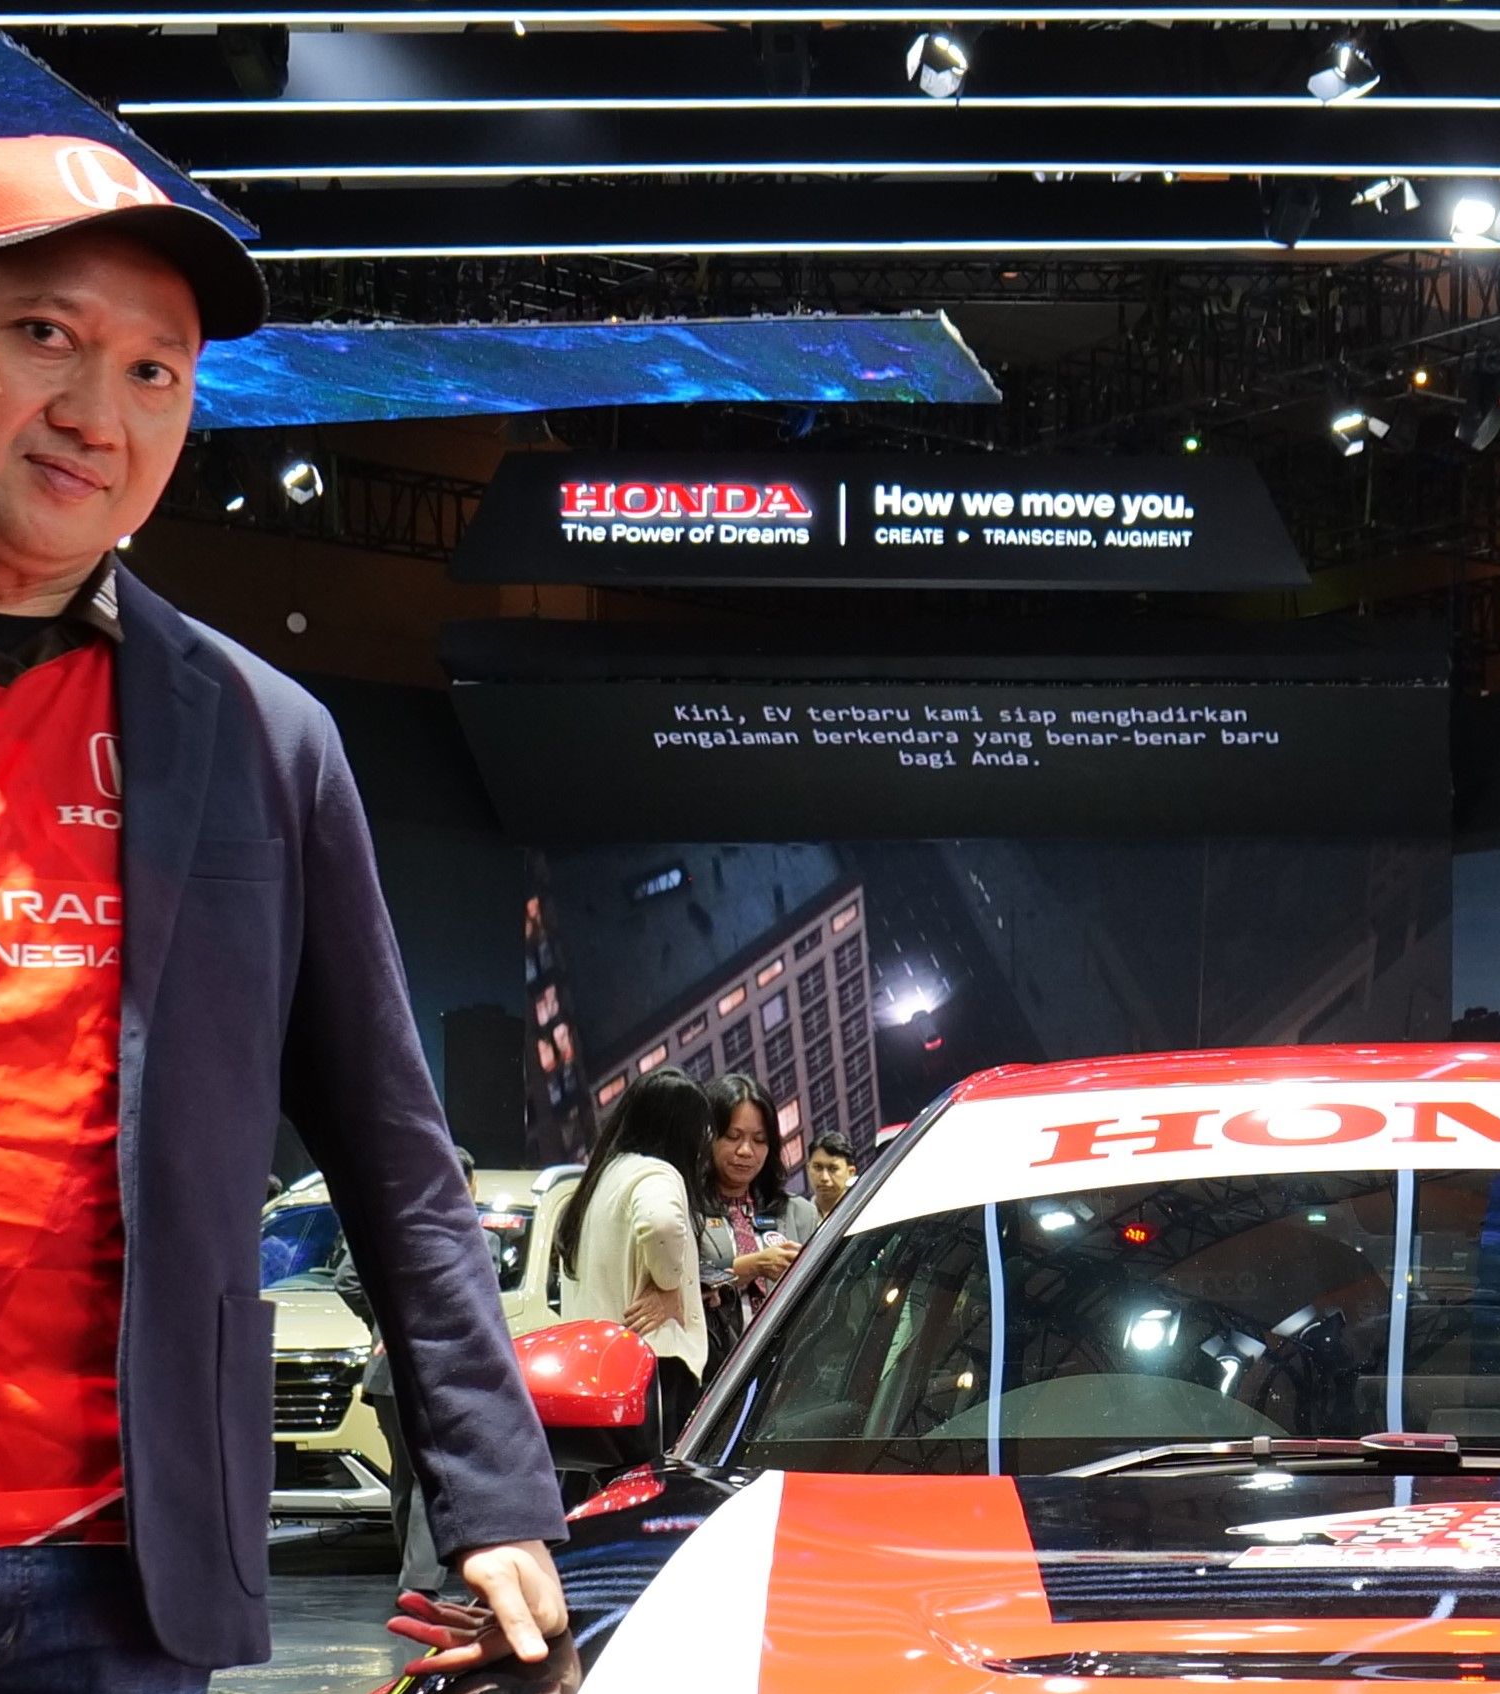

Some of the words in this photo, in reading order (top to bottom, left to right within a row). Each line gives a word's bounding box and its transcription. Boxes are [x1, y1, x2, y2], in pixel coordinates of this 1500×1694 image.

[560, 482, 813, 519] HONDA
[874, 484, 954, 517] How
[961, 492, 1014, 518] we
[1021, 493, 1116, 519] move
[1122, 494, 1195, 525] you.
[562, 523, 606, 543] The
[611, 523, 685, 543] Power
[688, 522, 715, 544] of
[719, 524, 810, 545] Dreams
[874, 527, 945, 546] CREATE
[982, 529, 1099, 550] TRANSCEND,
[1104, 530, 1194, 549] AUGMENT
[673, 705, 748, 726] Kini,
[762, 705, 793, 723] EV
[806, 705, 911, 723] terbaru
[924, 705, 983, 723] kami
[999, 706, 1057, 726] siap
[1070, 706, 1249, 727] menghadirkan
[653, 729, 801, 749] pengalaman
[812, 728, 960, 746] berkendara
[973, 730, 1033, 749] yang
[1046, 729, 1207, 747] benar-benar
[1221, 729, 1280, 746] baru
[899, 750, 957, 769] bagi
[971, 750, 1041, 768] Anda.
